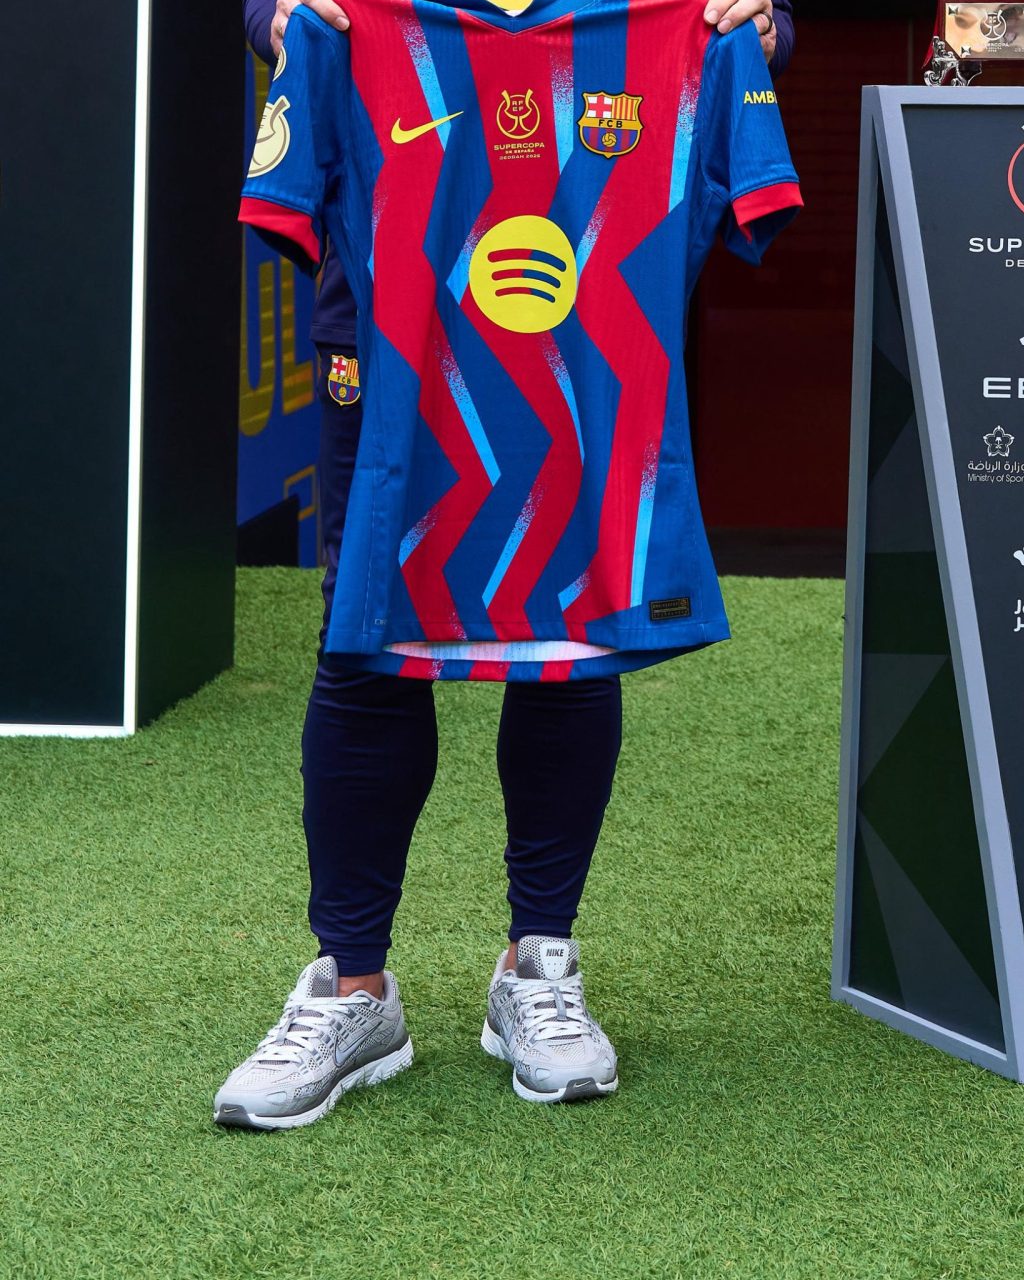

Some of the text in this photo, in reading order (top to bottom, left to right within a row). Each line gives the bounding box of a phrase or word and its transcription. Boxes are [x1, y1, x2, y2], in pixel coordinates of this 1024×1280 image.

[598, 119, 623, 128] FCB
[493, 142, 545, 151] SUPERCOPA
[967, 460, 1001, 473] الرياضة
[967, 473, 995, 483] Ministry
[996, 473, 1004, 482] of
[545, 948, 565, 957] NIKE
